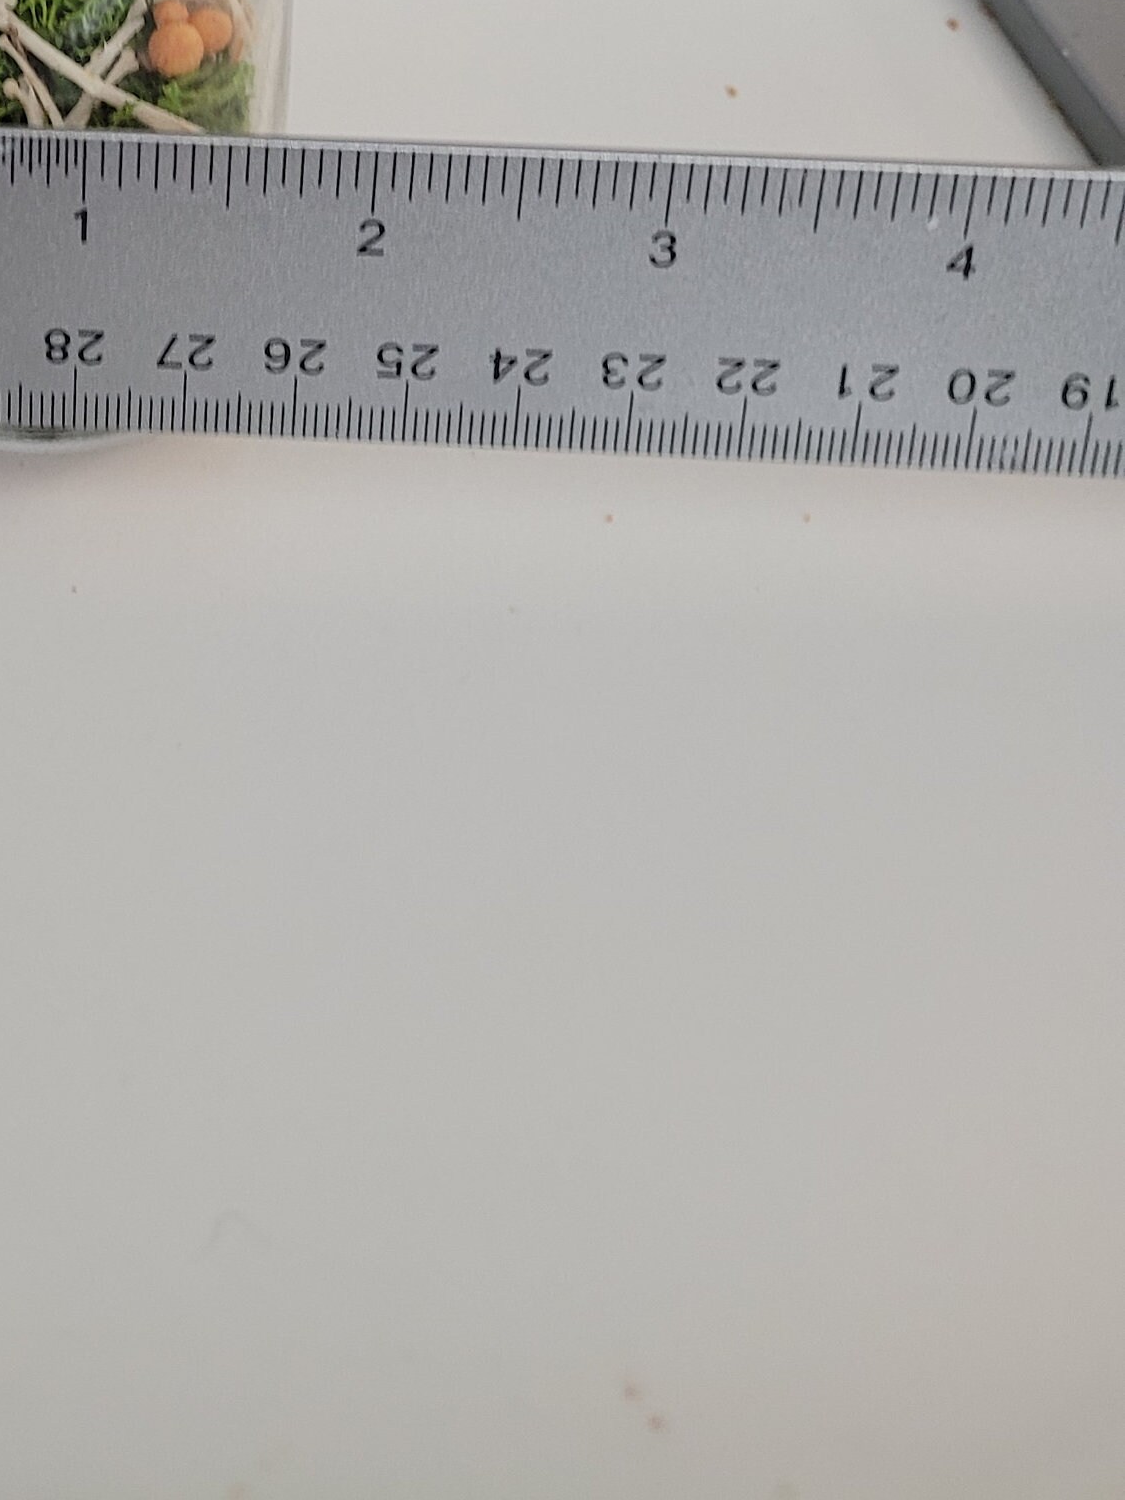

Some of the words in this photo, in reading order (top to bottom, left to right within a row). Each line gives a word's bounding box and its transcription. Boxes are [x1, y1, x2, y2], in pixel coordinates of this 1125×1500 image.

[74, 208, 88, 243] 1
[356, 218, 386, 257] 2
[648, 229, 677, 269] 3
[945, 244, 976, 282] 4
[43, 328, 105, 365] 28
[156, 332, 217, 371] 27
[263, 337, 328, 376] 26
[375, 342, 441, 382] 25
[488, 347, 554, 387] 24
[601, 351, 668, 392] 23
[715, 356, 782, 396] 22
[836, 362, 901, 402] 21
[946, 367, 1017, 407] 20
[1060, 371, 1121, 412] 19
